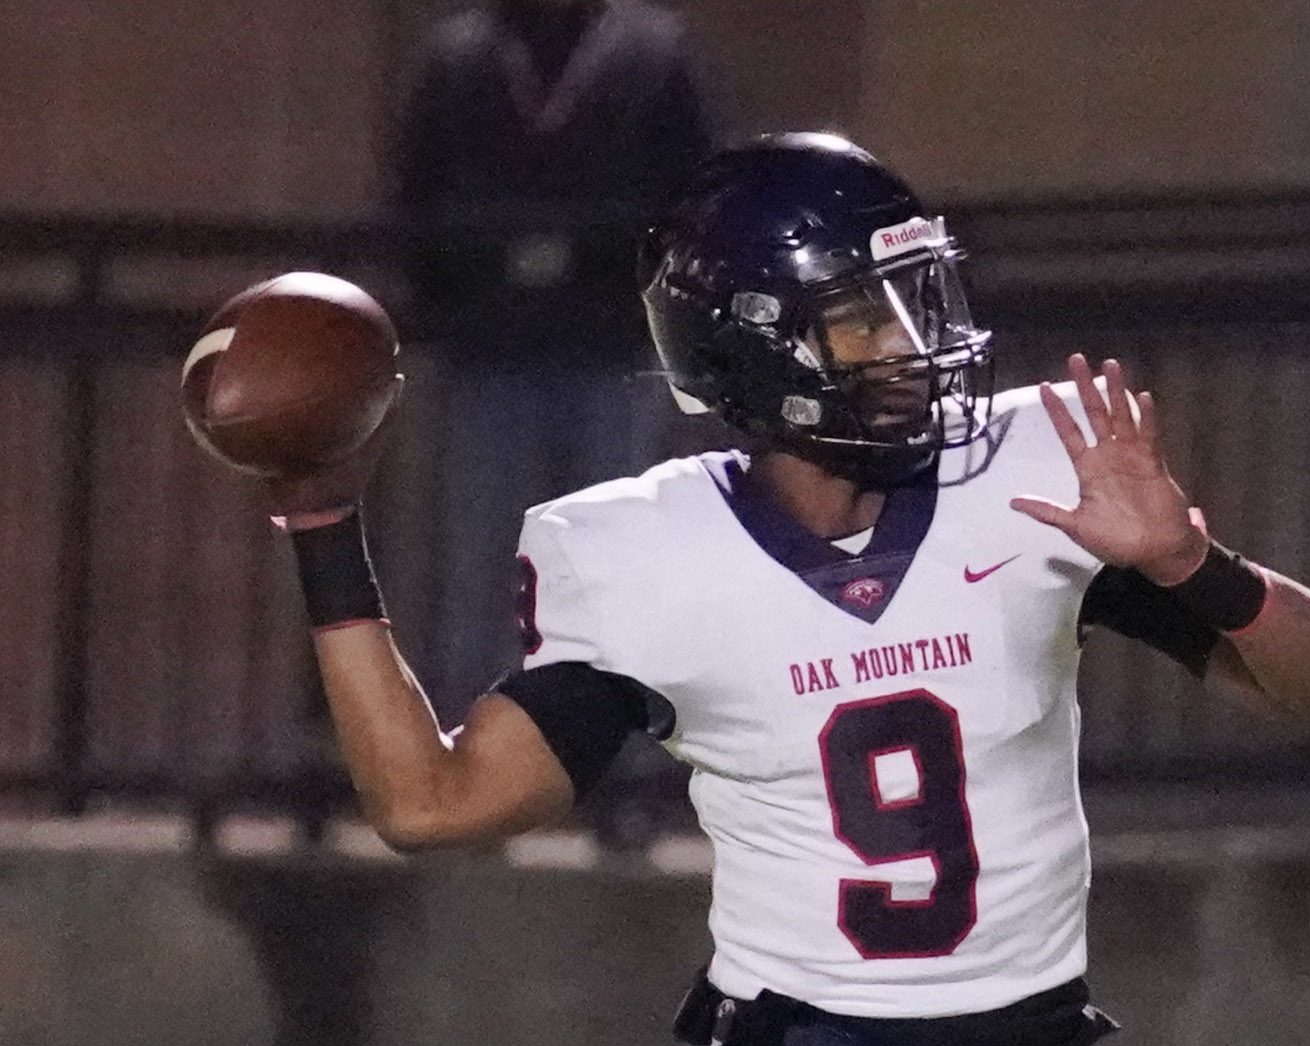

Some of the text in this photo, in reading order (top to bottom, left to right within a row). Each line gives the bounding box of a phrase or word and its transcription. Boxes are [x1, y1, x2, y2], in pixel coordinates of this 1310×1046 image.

[789, 632, 973, 696] OAK MOUNTAIN
[817, 687, 980, 960] 9
